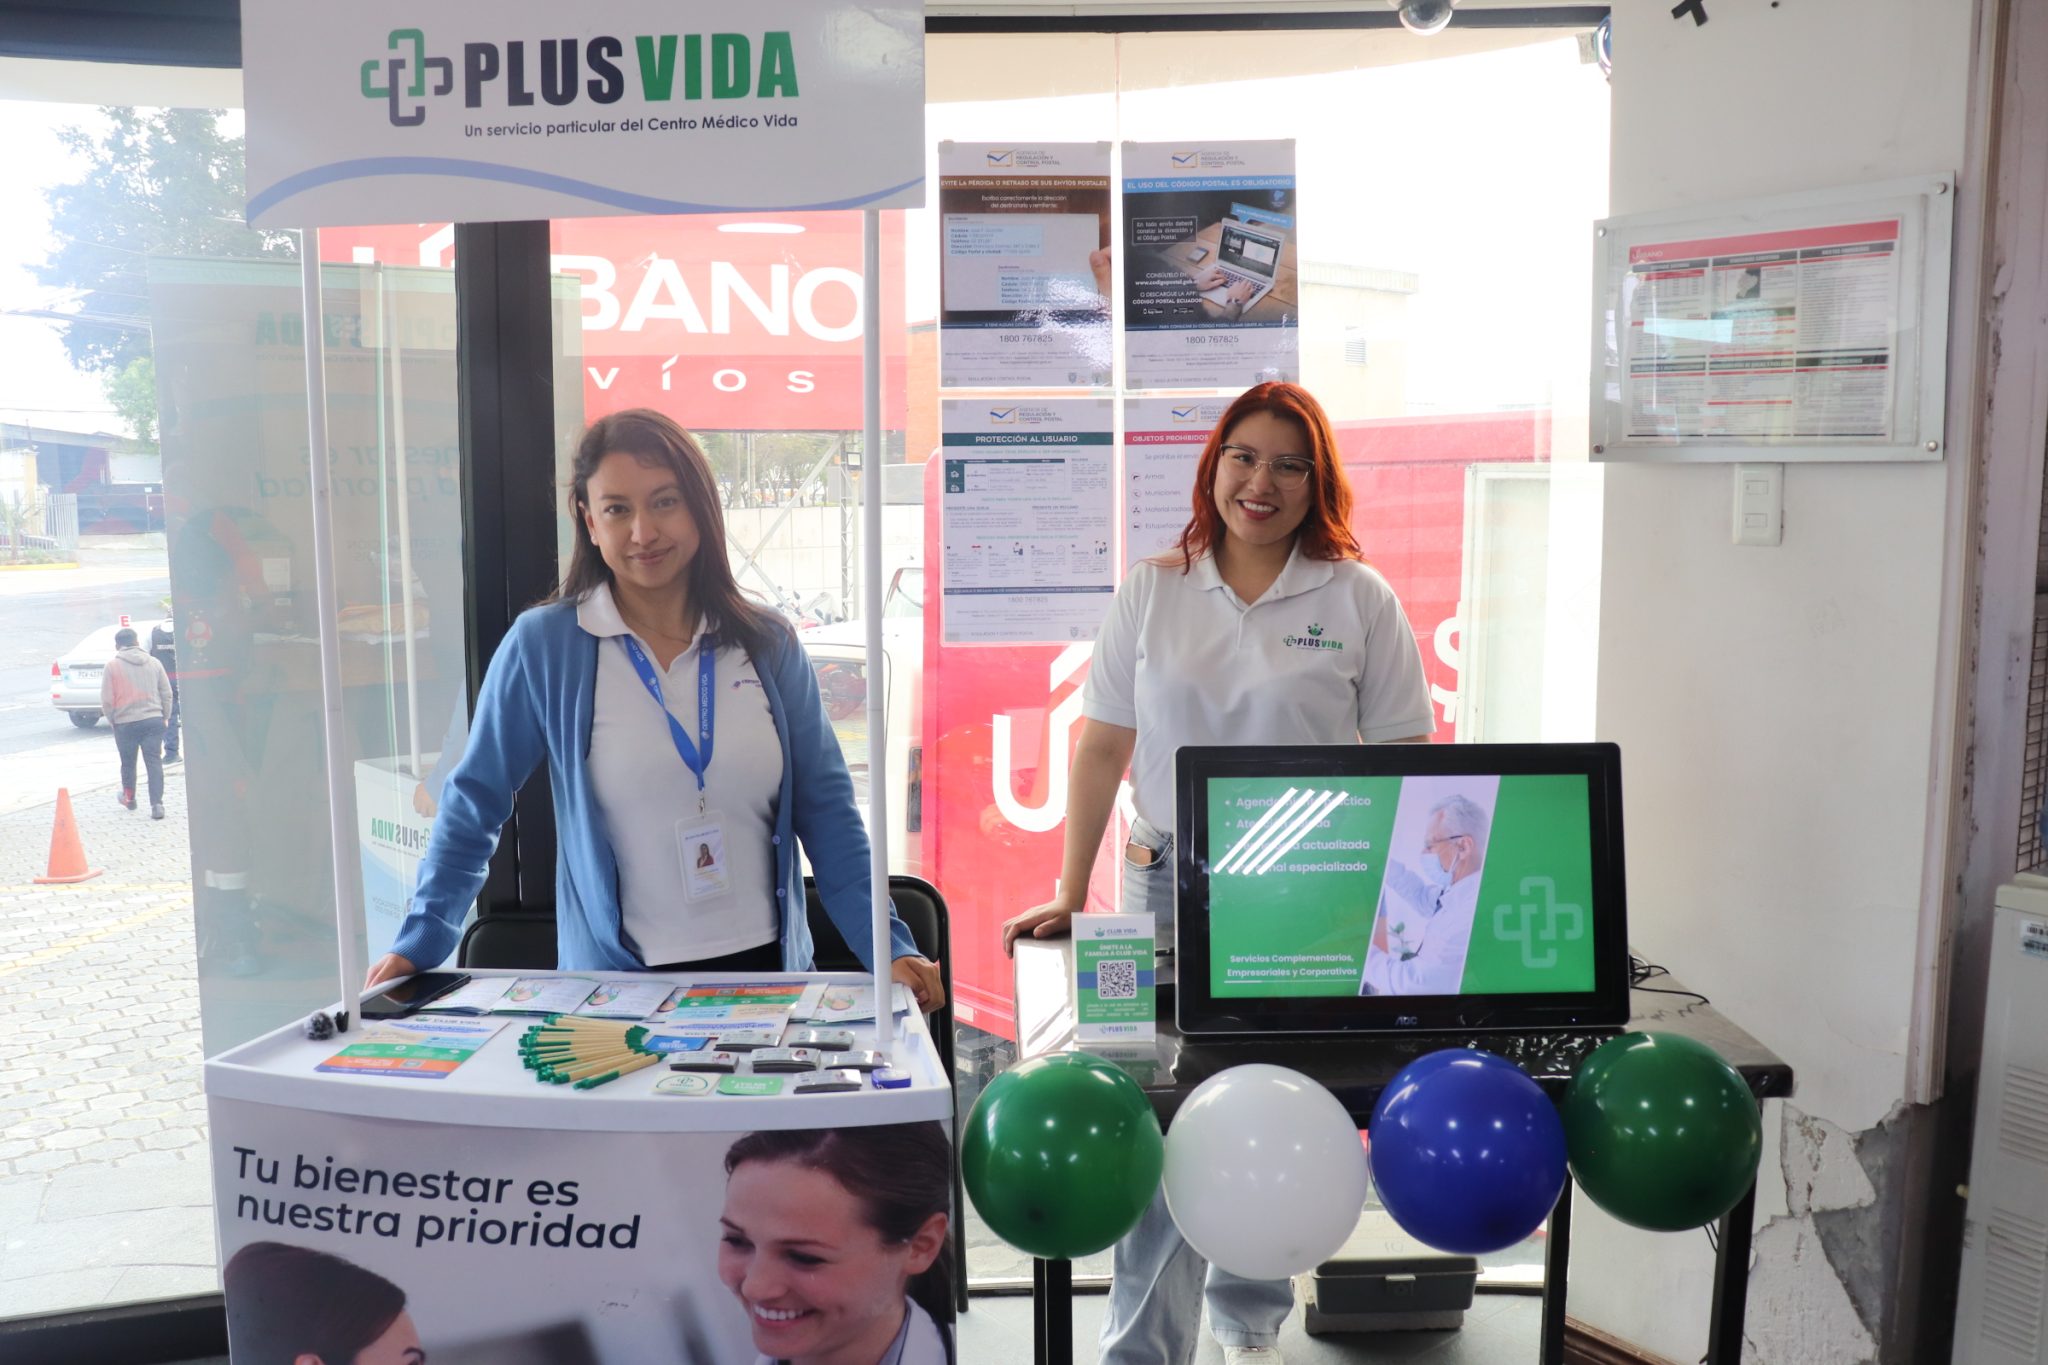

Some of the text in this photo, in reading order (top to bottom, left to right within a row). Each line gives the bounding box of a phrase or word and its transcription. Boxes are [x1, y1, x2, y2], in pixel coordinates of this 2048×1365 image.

[464, 31, 798, 108] PLUS VIDA
[464, 114, 798, 137] Un servicio particular del Centro Médico Vida
[1208, 335, 1239, 343] 767825
[1297, 638, 1343, 650] PLUS VIDA
[1302, 839, 1370, 850] actualizada
[1289, 861, 1368, 875] especializado
[1230, 954, 1354, 965] Servicios Complementarios,
[1227, 967, 1357, 978] Empresariales y Corporativos
[1395, 1016, 1418, 1026] AOC
[234, 1147, 579, 1206] Tu bienestar es
[238, 1194, 640, 1249] nuestra prioridad
